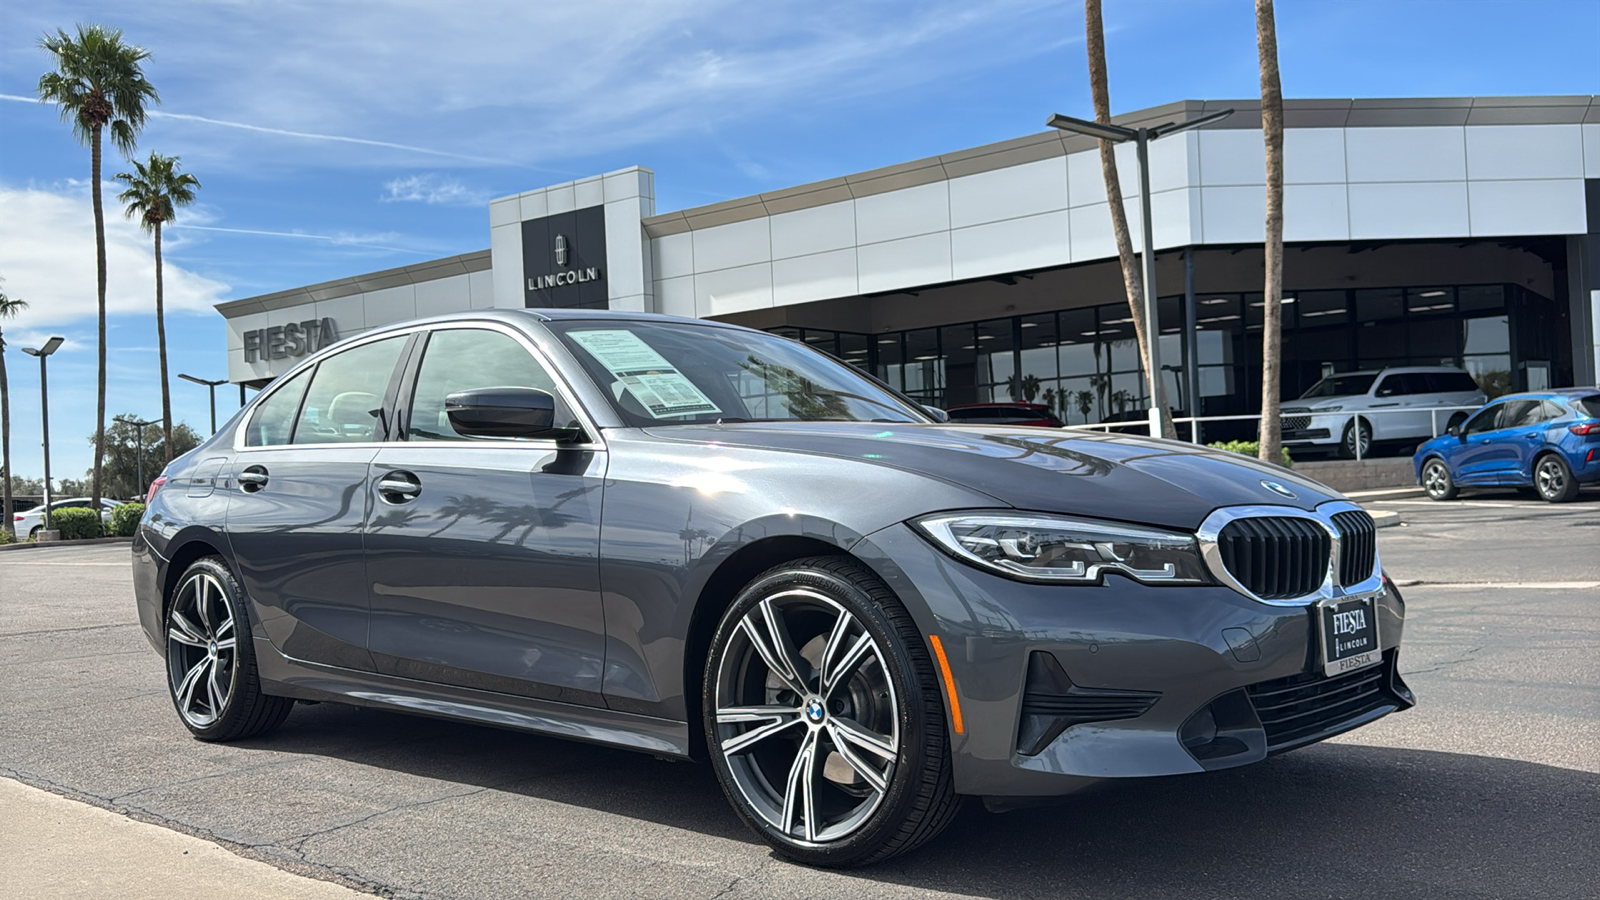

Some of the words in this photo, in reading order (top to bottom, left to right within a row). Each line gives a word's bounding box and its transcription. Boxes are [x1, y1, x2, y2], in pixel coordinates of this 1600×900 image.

[528, 267, 598, 290] LINCOLN
[243, 317, 339, 363] FIESTA
[1333, 609, 1367, 635] FIESTA
[1340, 637, 1368, 651] LINCOLN
[1339, 653, 1371, 671] FIESTA
